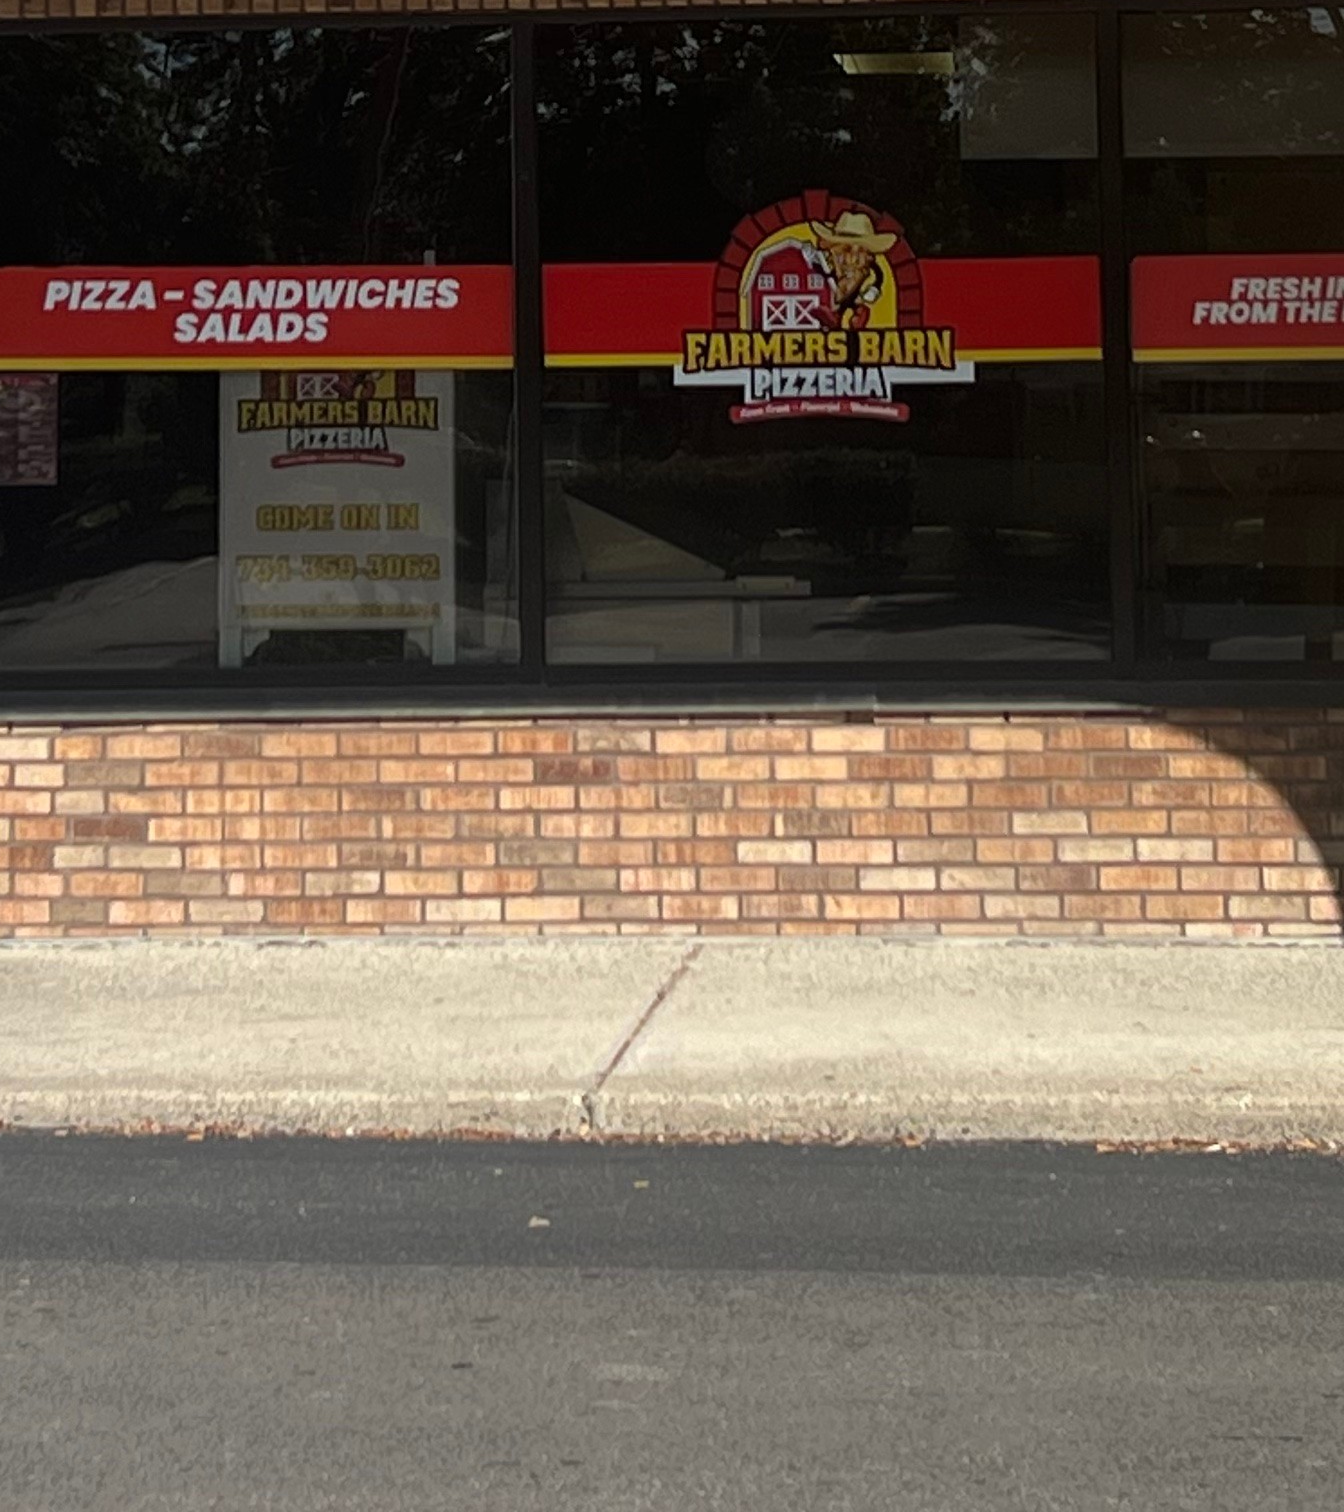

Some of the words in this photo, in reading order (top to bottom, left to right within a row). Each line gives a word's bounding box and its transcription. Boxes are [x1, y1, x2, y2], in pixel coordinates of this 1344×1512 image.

[44, 280, 156, 310] PIZZA
[192, 278, 460, 310] SANDWICHES
[1230, 277, 1323, 301] FRESH
[174, 313, 329, 343] SALADS
[1192, 302, 1278, 326] FROM
[1283, 301, 1337, 324] THE
[684, 332, 849, 372] FARMERS
[859, 330, 953, 369] BARN
[754, 368, 885, 397] PIZZERIA
[239, 401, 361, 430] FARMERS
[367, 399, 437, 429] BARN
[289, 428, 387, 451] PIZZERIA
[256, 504, 335, 531] COME
[340, 504, 380, 530] ON
[387, 503, 419, 530] IN
